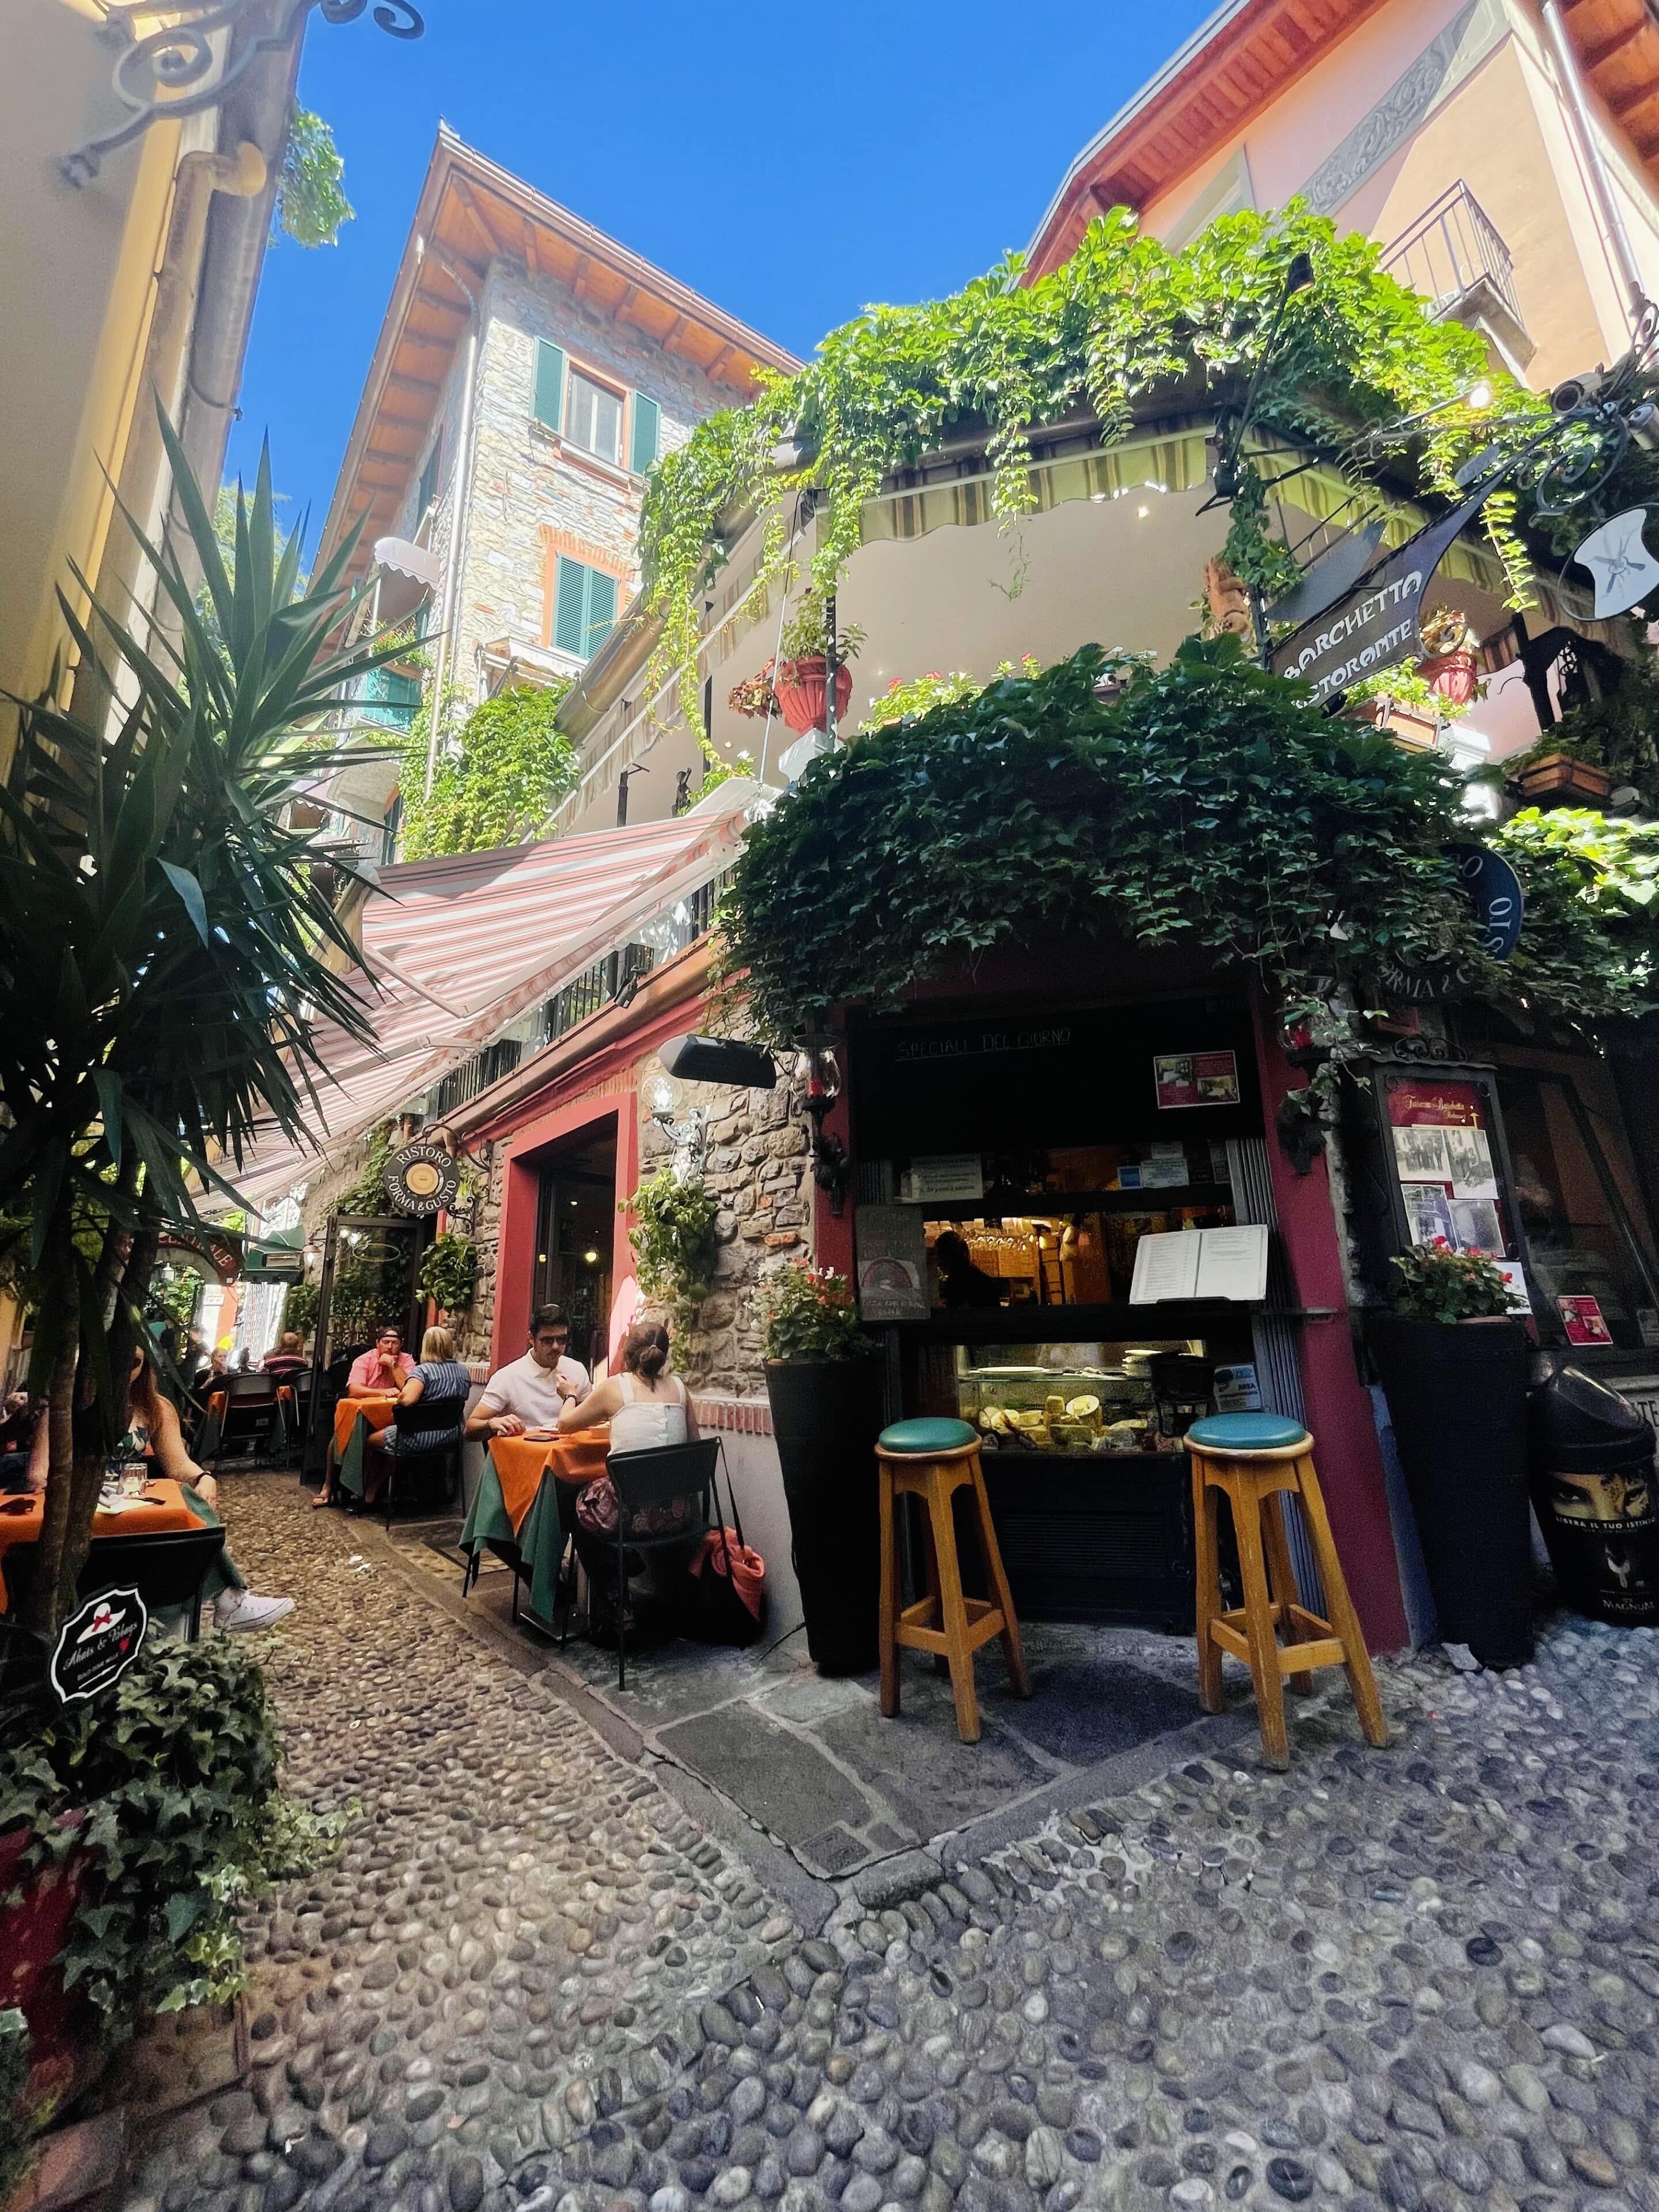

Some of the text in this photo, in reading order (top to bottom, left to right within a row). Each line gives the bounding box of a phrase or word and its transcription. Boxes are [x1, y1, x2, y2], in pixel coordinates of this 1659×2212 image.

[1283, 571, 1423, 680] BARCHETTA
[982, 1033, 1010, 1050] DEL
[1018, 1028, 1070, 1048] GIORNO
[396, 1146, 452, 1167] RISTORO
[388, 1175, 457, 1210] FORMA & GUSTO
[1556, 1516, 1587, 1528] LIBERA
[1626, 1516, 1656, 1528] ISTINTO
[1602, 1599, 1655, 1611] MAGNUM
[97, 1637, 108, 1650] &
